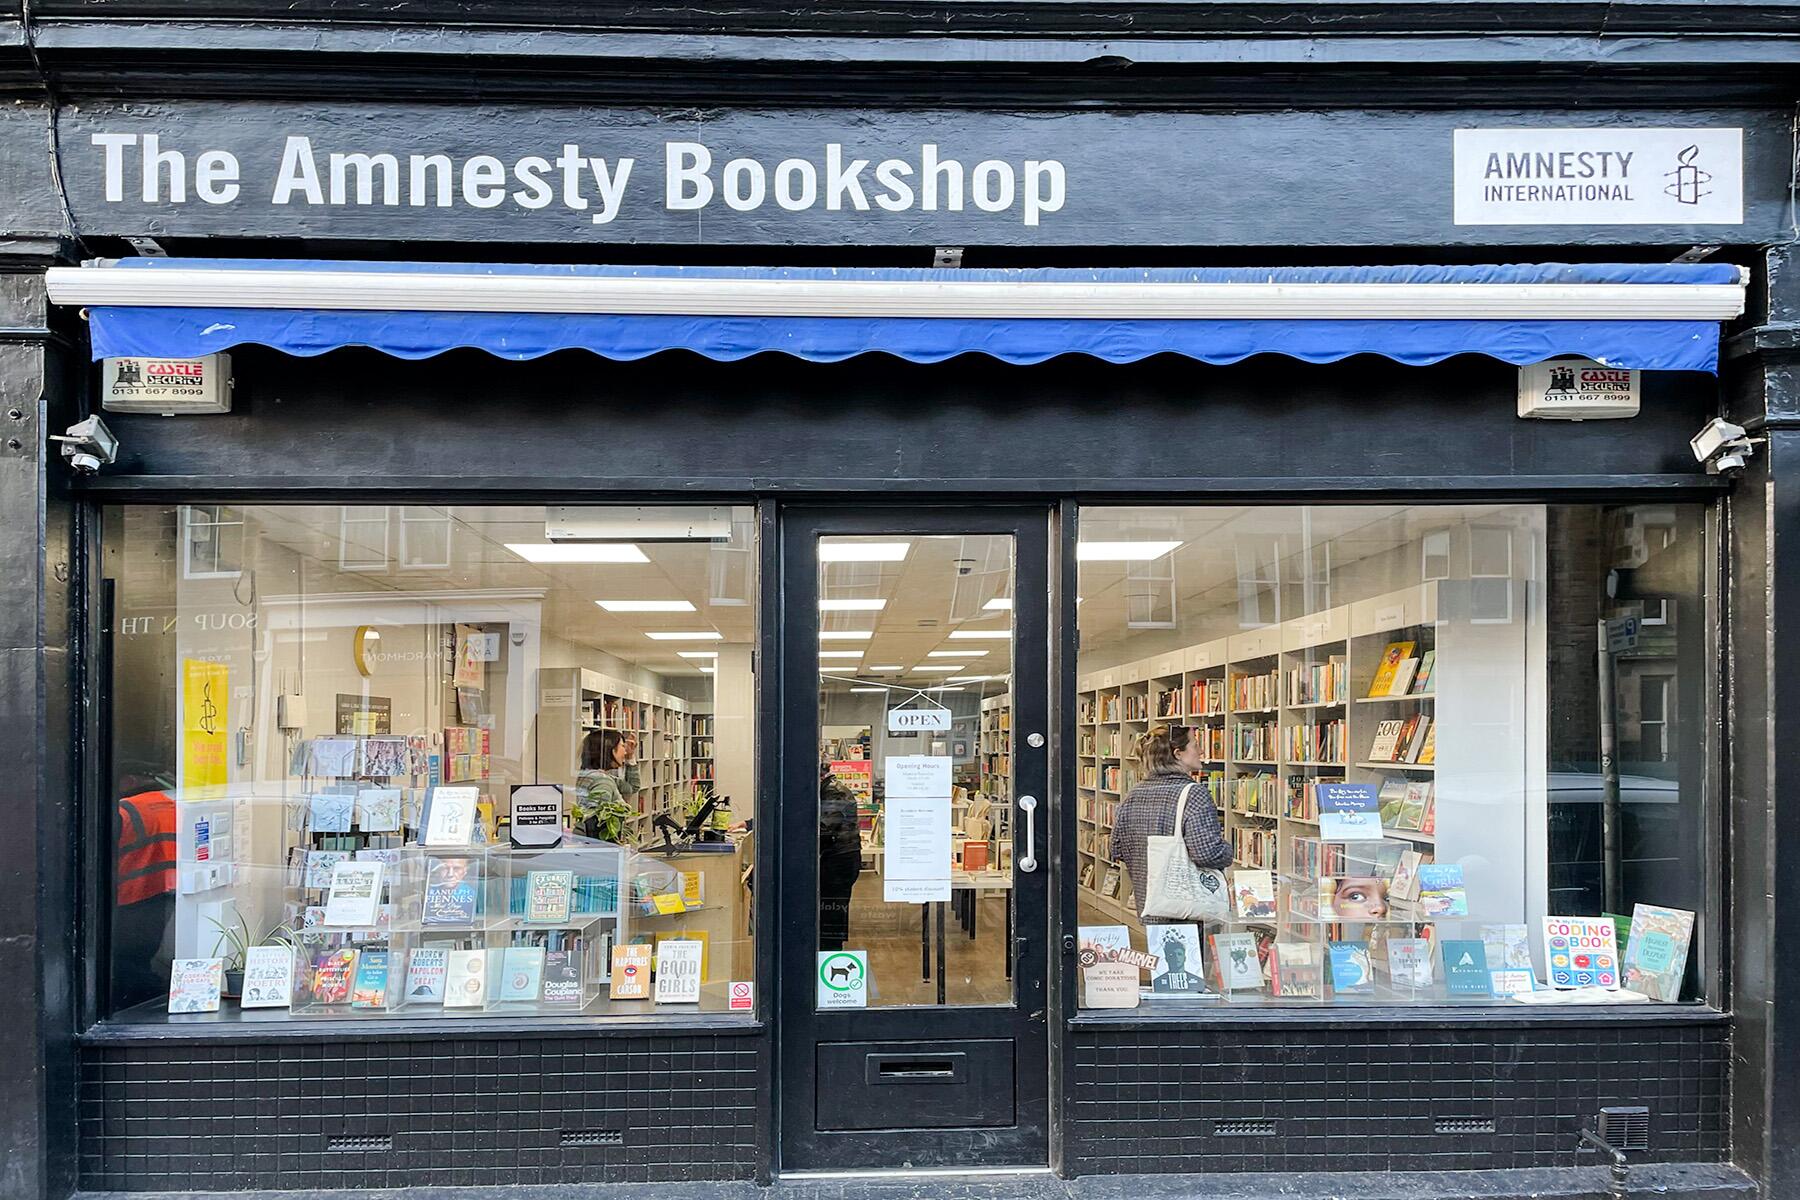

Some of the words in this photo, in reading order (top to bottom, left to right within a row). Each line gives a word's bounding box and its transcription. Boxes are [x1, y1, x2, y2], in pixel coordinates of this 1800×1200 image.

[1484, 151, 1634, 178] AMNESTY
[91, 133, 240, 204] The
[271, 136, 635, 224] Amnesty
[665, 141, 1066, 226] Bookshop
[1484, 184, 1635, 202] INTERNATIONAL
[147, 364, 203, 376] CASTLE
[148, 376, 202, 385] SECURITY
[1580, 371, 1630, 382] CASTLE
[1581, 382, 1630, 391] SECURITY
[898, 714, 942, 726] OPEN
[430, 888, 471, 896] RANULPH
[427, 895, 473, 903] FIENNES
[1548, 924, 1611, 937] CODING
[1570, 936, 1612, 948] BOOK
[415, 950, 444, 958] ANDREW
[672, 950, 687, 959] THE
[249, 957, 289, 965] HISTORY
[1118, 949, 1159, 970] MARVEL
[660, 960, 697, 978] GOOD
[247, 980, 287, 988] POETRY
[414, 977, 437, 985] GREAT
[545, 981, 578, 990] Douglas
[660, 979, 696, 993] GIRLS
[1167, 972, 1189, 990] TREES
[544, 988, 584, 996] Coupland
[833, 992, 851, 1000] Dogs
